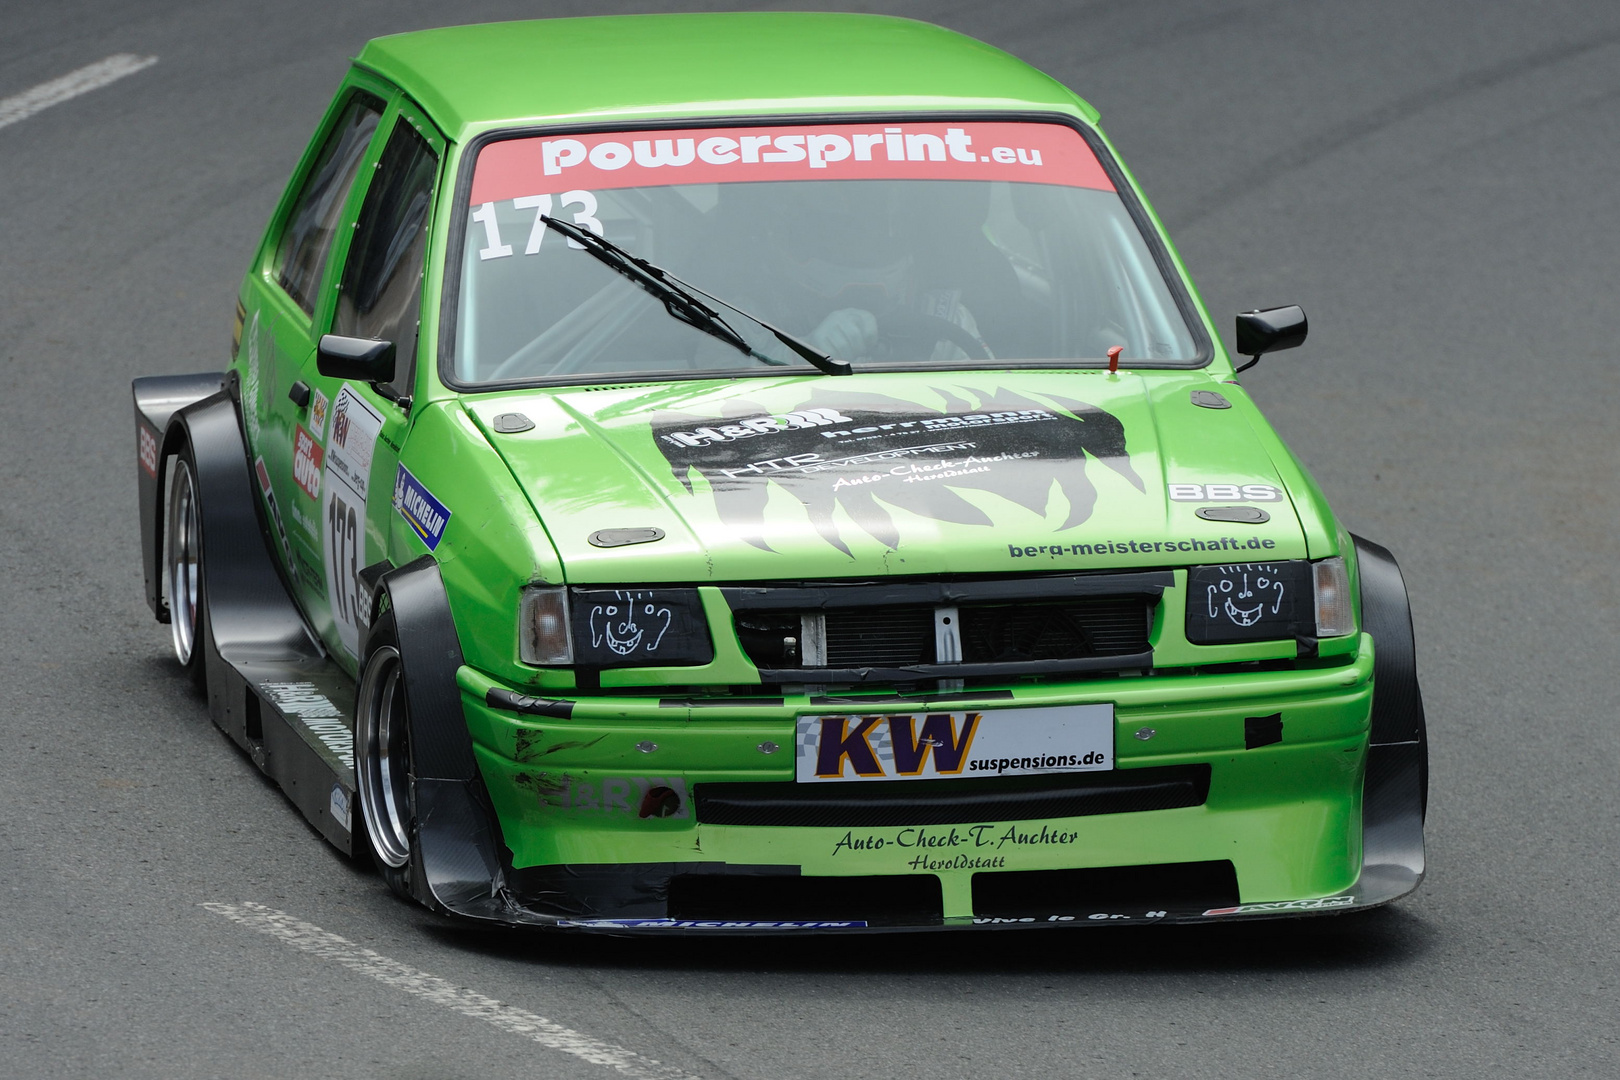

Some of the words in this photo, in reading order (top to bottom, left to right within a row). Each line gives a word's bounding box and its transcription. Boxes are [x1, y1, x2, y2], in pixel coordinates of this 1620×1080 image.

[541, 127, 1044, 176] powersprint.eu
[472, 189, 604, 261] 173
[671, 416, 790, 447] H&R
[140, 426, 156, 471] BBS
[800, 442, 976, 474] DEVELOPMENT
[294, 449, 320, 498] auto
[720, 452, 826, 479] HTR
[1167, 483, 1281, 502] BBS
[404, 485, 445, 538] MICHELIN
[329, 491, 360, 630] 173
[1008, 536, 1276, 560] berg-meisterschaft.de
[813, 712, 984, 779] KW
[969, 751, 1105, 773] suspensions.de
[908, 854, 1005, 870] Heroldstatt
[636, 920, 852, 928] MICHELIN
